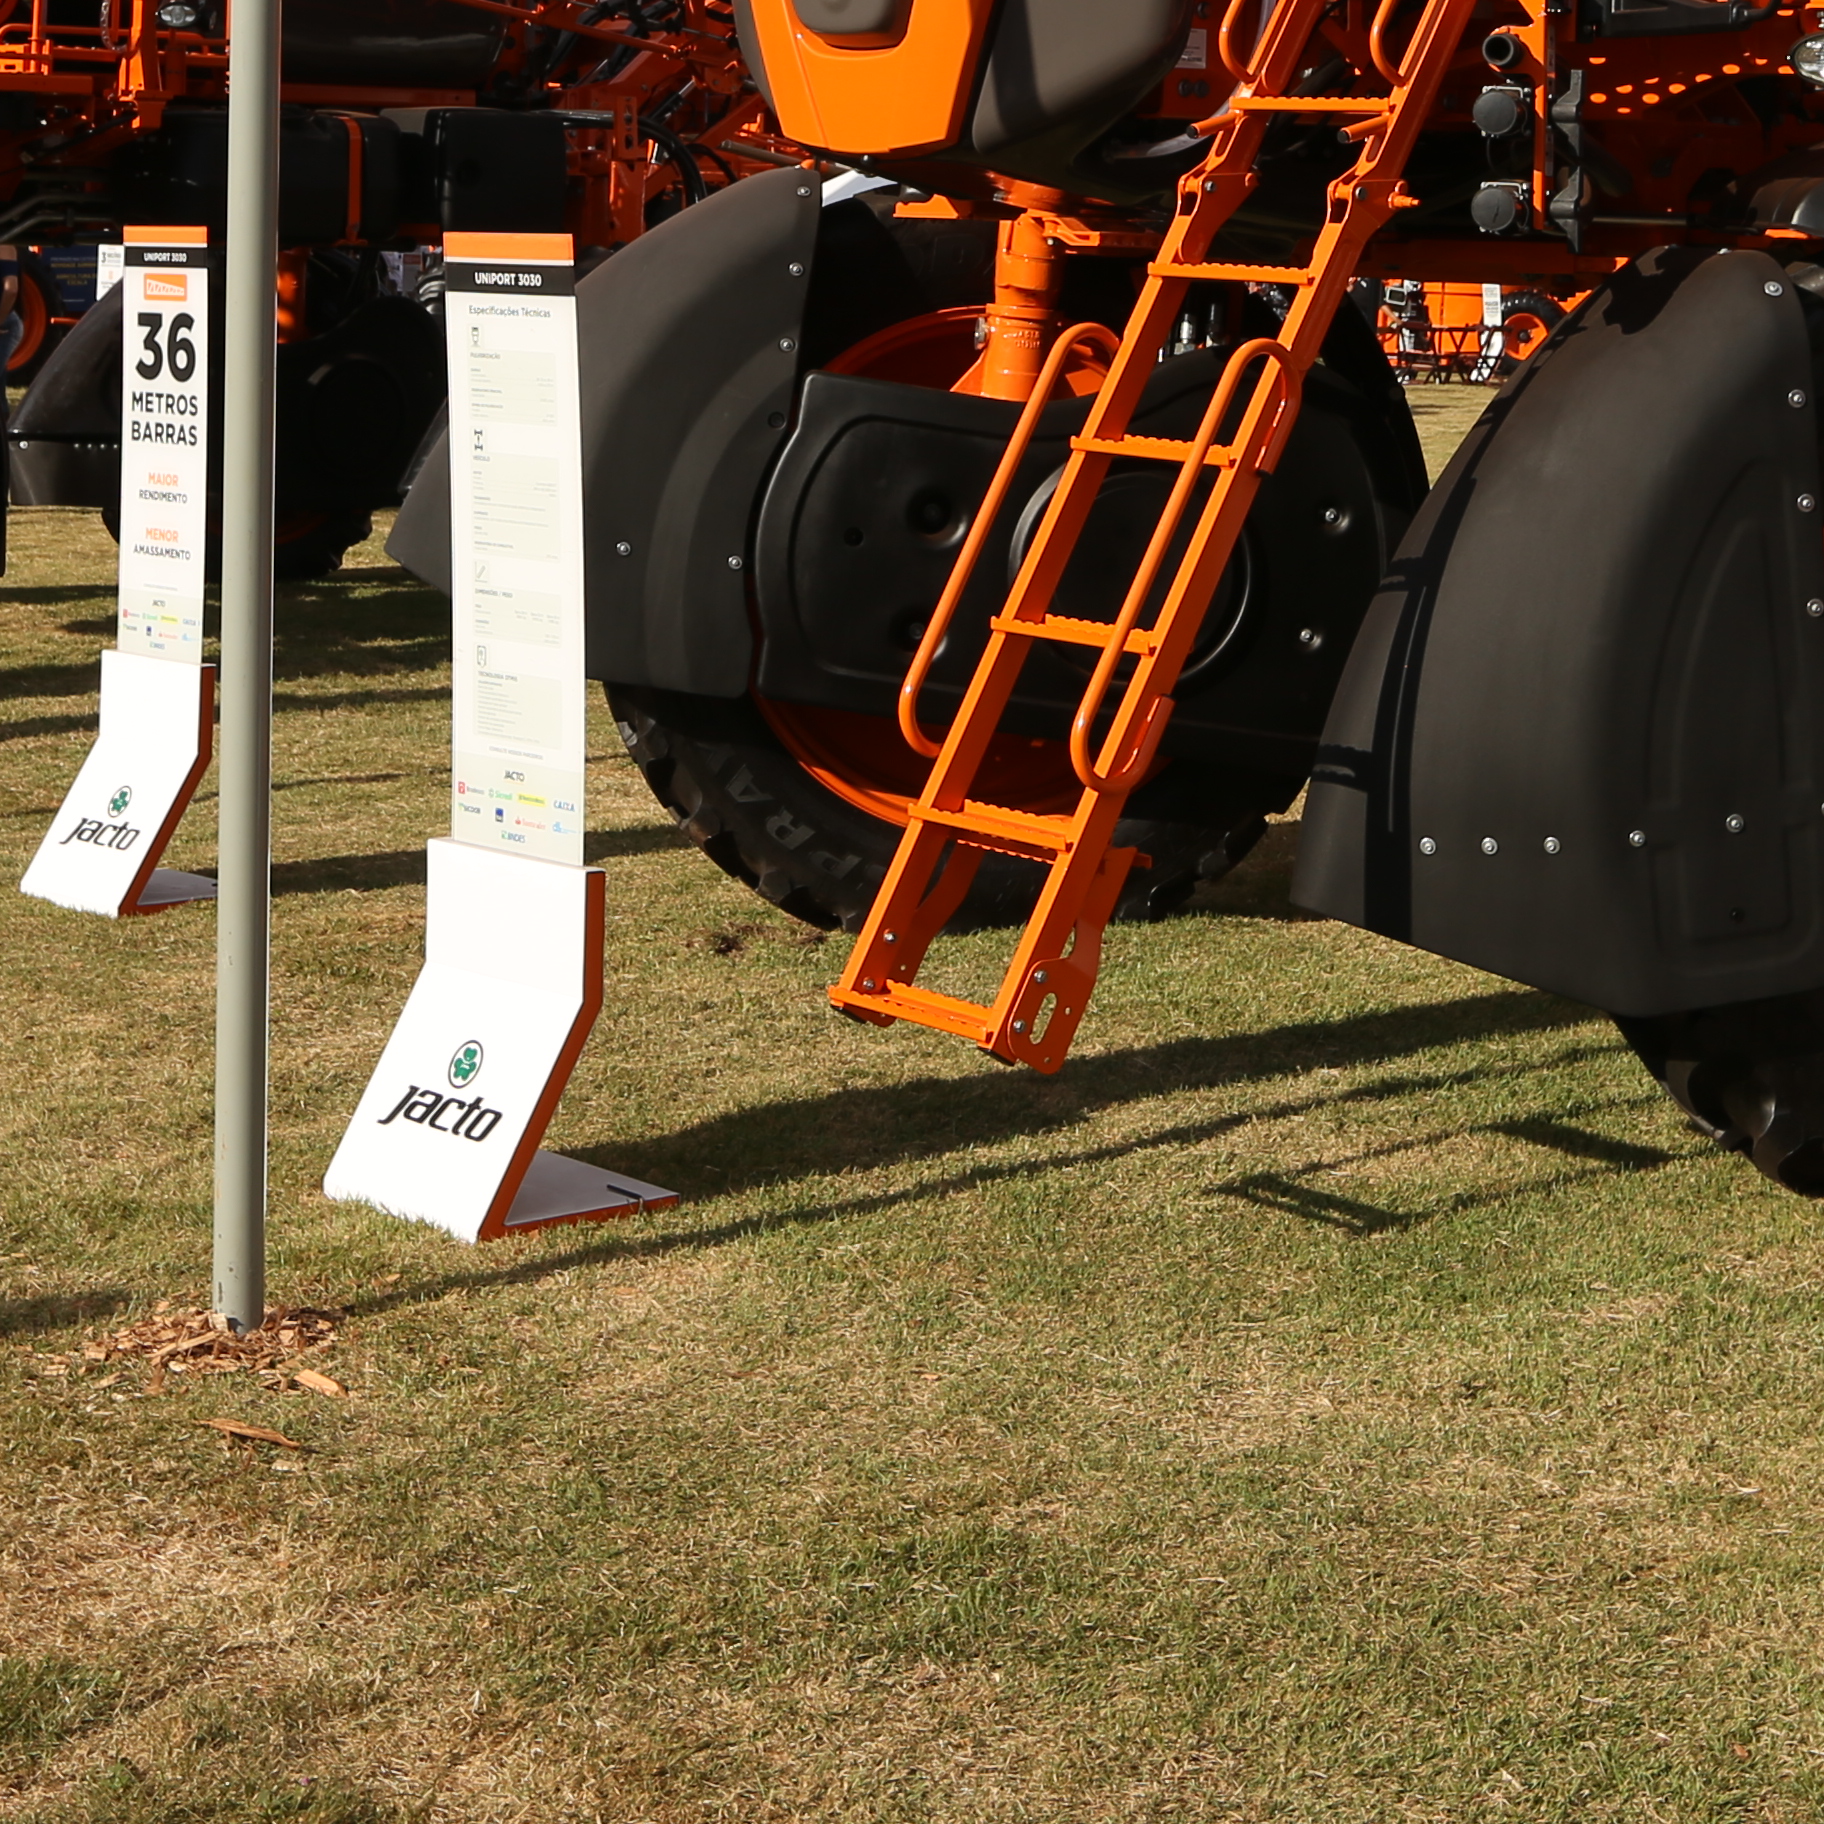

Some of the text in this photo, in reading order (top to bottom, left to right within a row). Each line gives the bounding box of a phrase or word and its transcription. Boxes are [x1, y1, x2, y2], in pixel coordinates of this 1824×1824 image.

[143, 252, 171, 262] UNIPORT
[474, 272, 542, 286] UNIPORT 3030
[468, 305, 551, 318] Especificações Técnicas
[135, 312, 196, 383] 36
[132, 391, 198, 416] METROS
[131, 420, 198, 447] BARRAS
[148, 472, 179, 487] MAIOR
[139, 489, 188, 504] RENDIMENTO
[146, 527, 179, 543] MENOR
[133, 544, 191, 561] AMASSAMENTO
[59, 817, 141, 851] jacto
[377, 1084, 503, 1142] jacto
